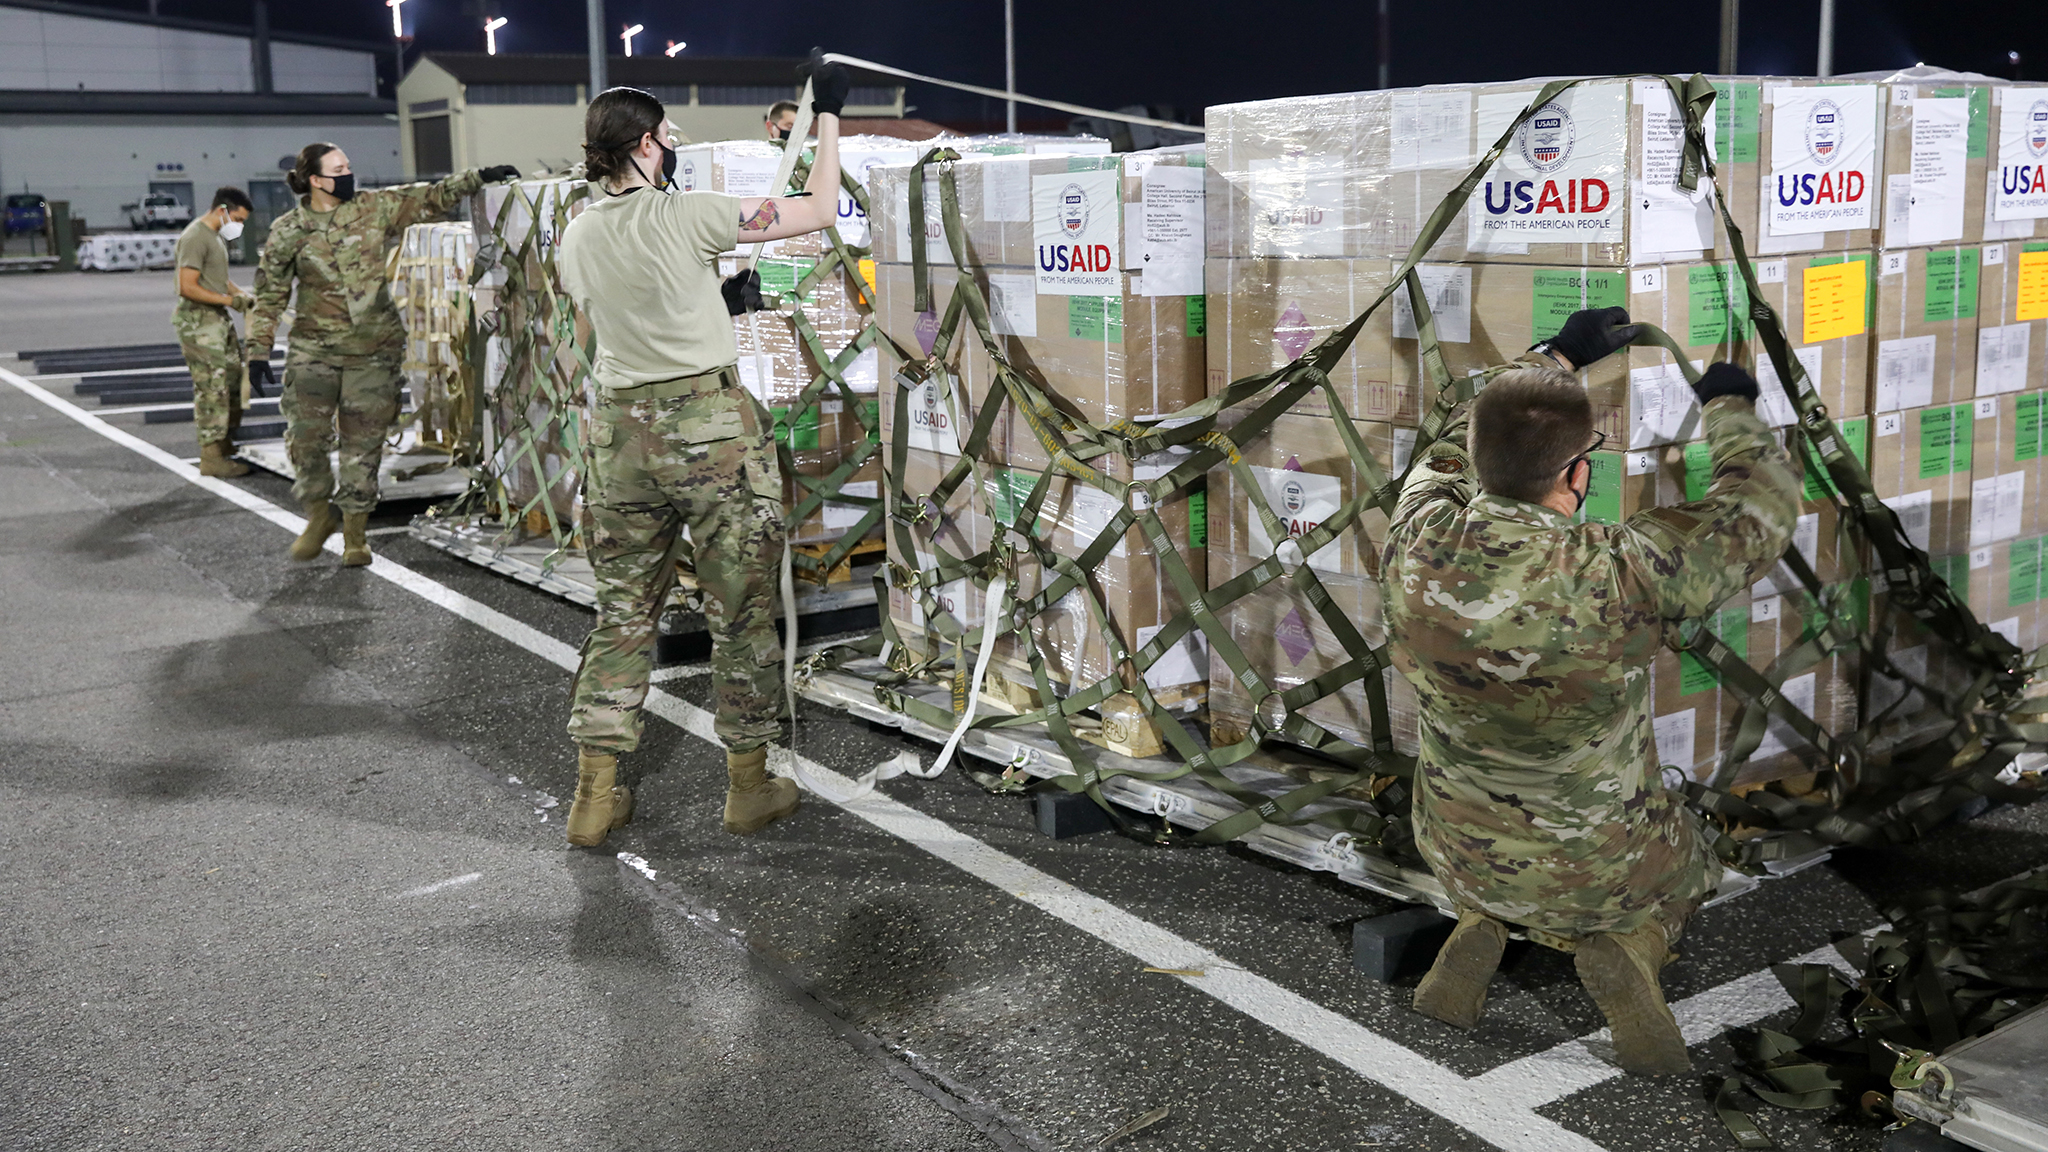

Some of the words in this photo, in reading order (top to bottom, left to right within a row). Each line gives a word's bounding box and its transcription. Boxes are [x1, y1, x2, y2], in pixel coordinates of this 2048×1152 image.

[1718, 90, 1730, 100] BO
[1738, 90, 1748, 100] 1/1
[1899, 90, 1908, 100] 32
[2003, 165, 2048, 195] USA
[1778, 170, 1864, 206] USAID
[1485, 178, 1610, 215] USAID
[1777, 212, 1795, 221] FROM
[1797, 211, 1809, 220] THE
[1810, 209, 1841, 219] AMERICAN
[1843, 207, 1863, 216] PEOPLE
[1484, 220, 1507, 229] FROM
[1511, 220, 1526, 229] THE
[1529, 220, 1574, 229] AMERICAN
[1577, 219, 1610, 228] PEOPLE
[1039, 244, 1111, 272] USAID
[1989, 249, 1997, 259] 27
[1890, 258, 1898, 269] 28
[1767, 266, 1776, 277] 11
[1041, 276, 1055, 284] FROM
[1056, 276, 1066, 284] THE
[1067, 276, 1093, 284] AMERICAN
[1094, 277, 1114, 285] PEOPLE
[1595, 279, 1608, 288] 1/1
[1642, 274, 1653, 285] 12
[1982, 403, 1990, 413] 23
[914, 409, 947, 428] USAID
[1885, 419, 1894, 430] 24
[1641, 456, 1646, 468] 8
[1763, 604, 1768, 614] 3
[1106, 721, 1124, 739] EPAL
